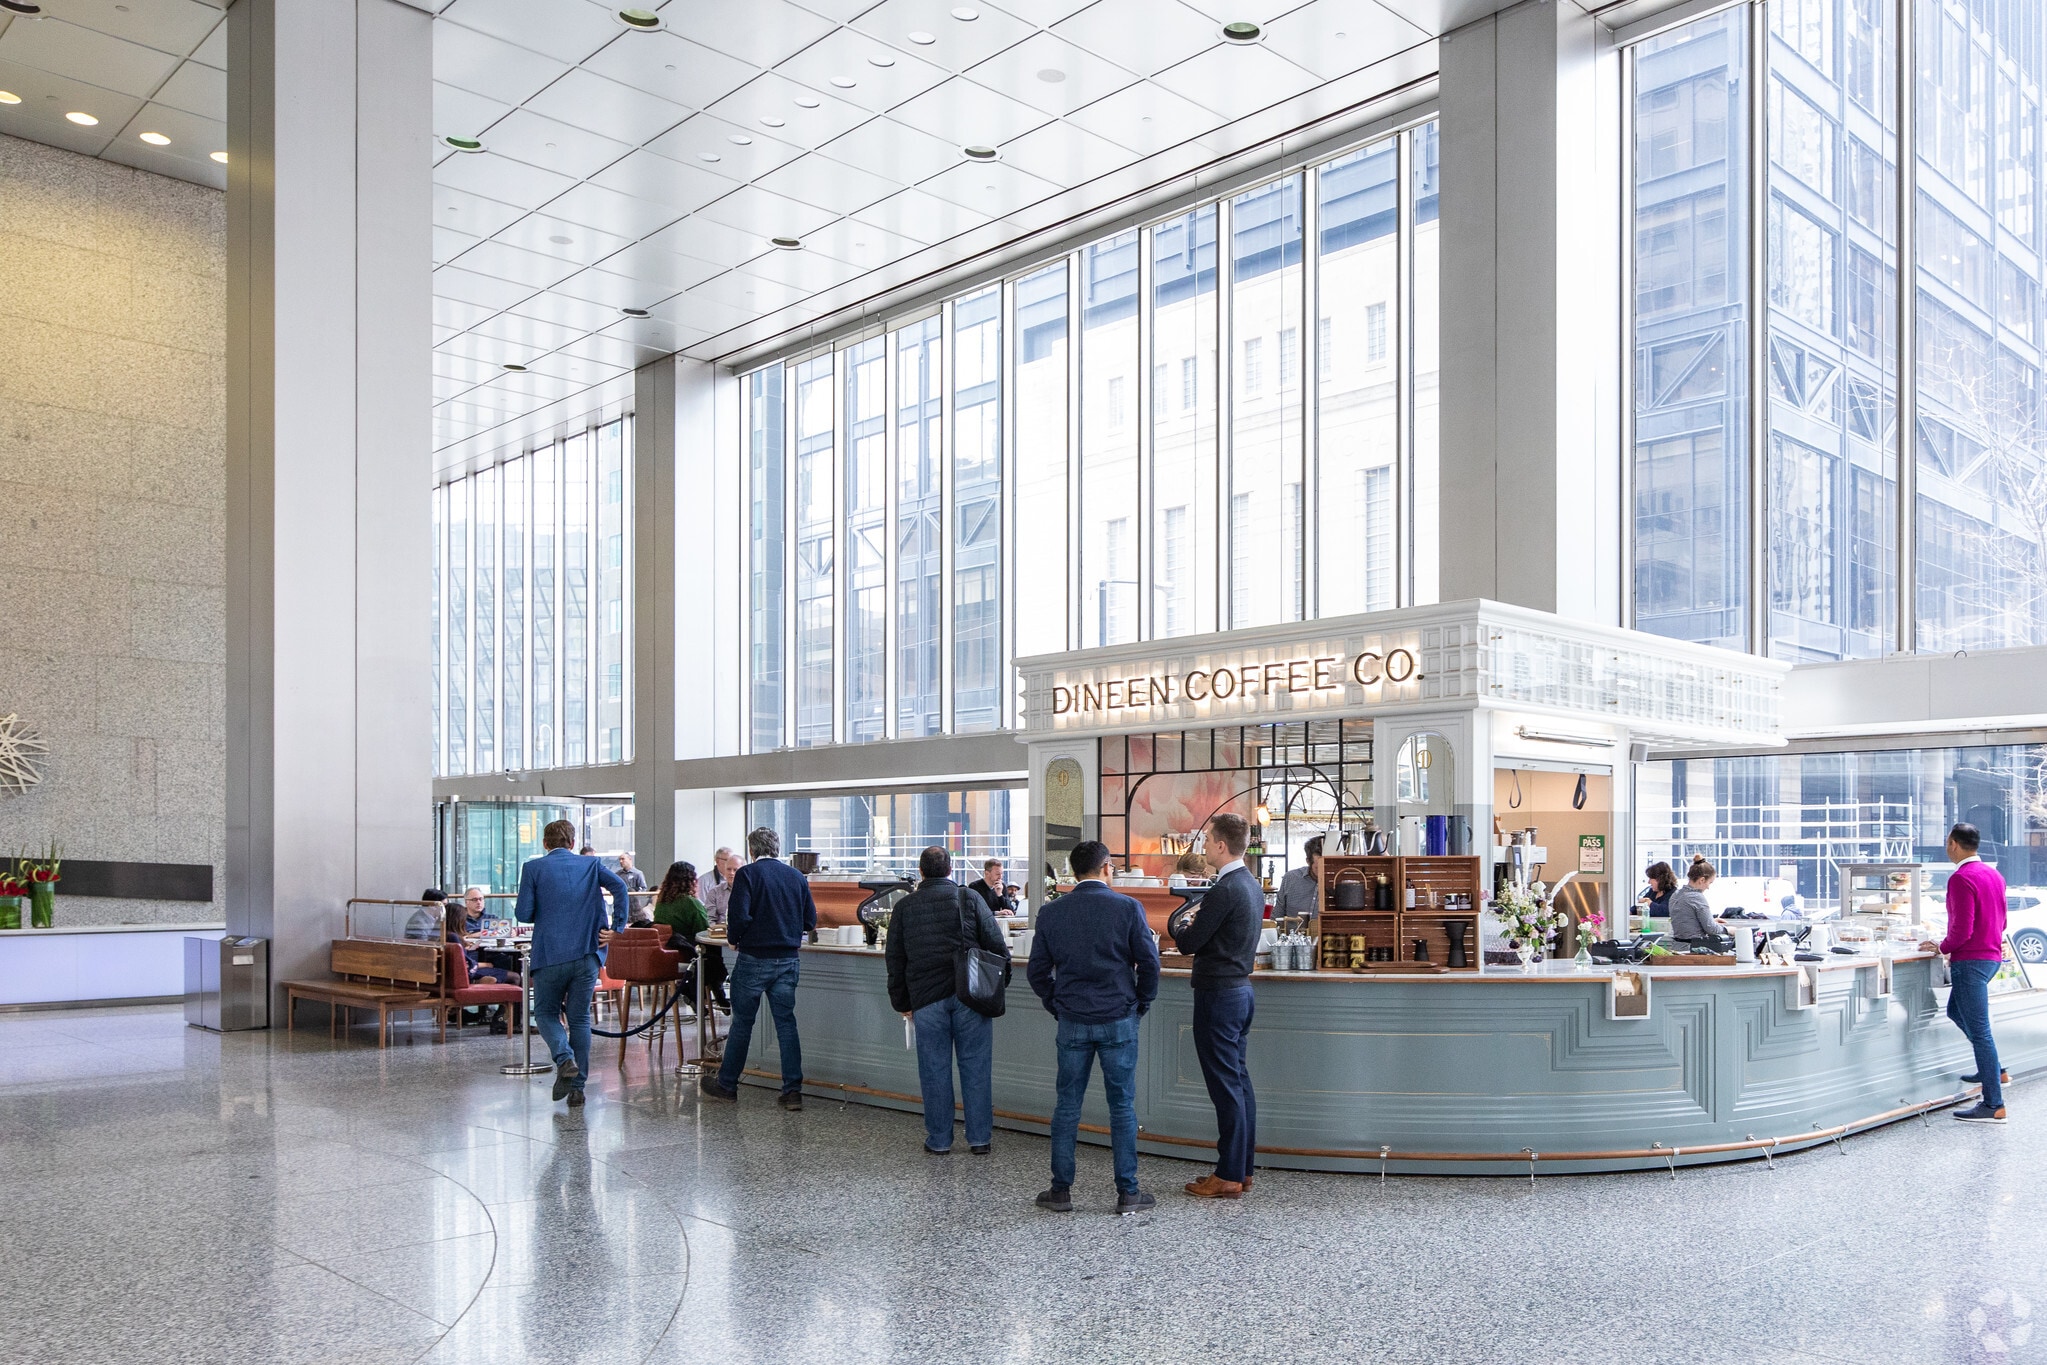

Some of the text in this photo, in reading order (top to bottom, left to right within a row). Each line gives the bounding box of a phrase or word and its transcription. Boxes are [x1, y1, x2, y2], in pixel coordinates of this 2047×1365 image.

[1053, 649, 1425, 714] DINEEN COFFEE CO.
[1583, 839, 1601, 847] PASS
